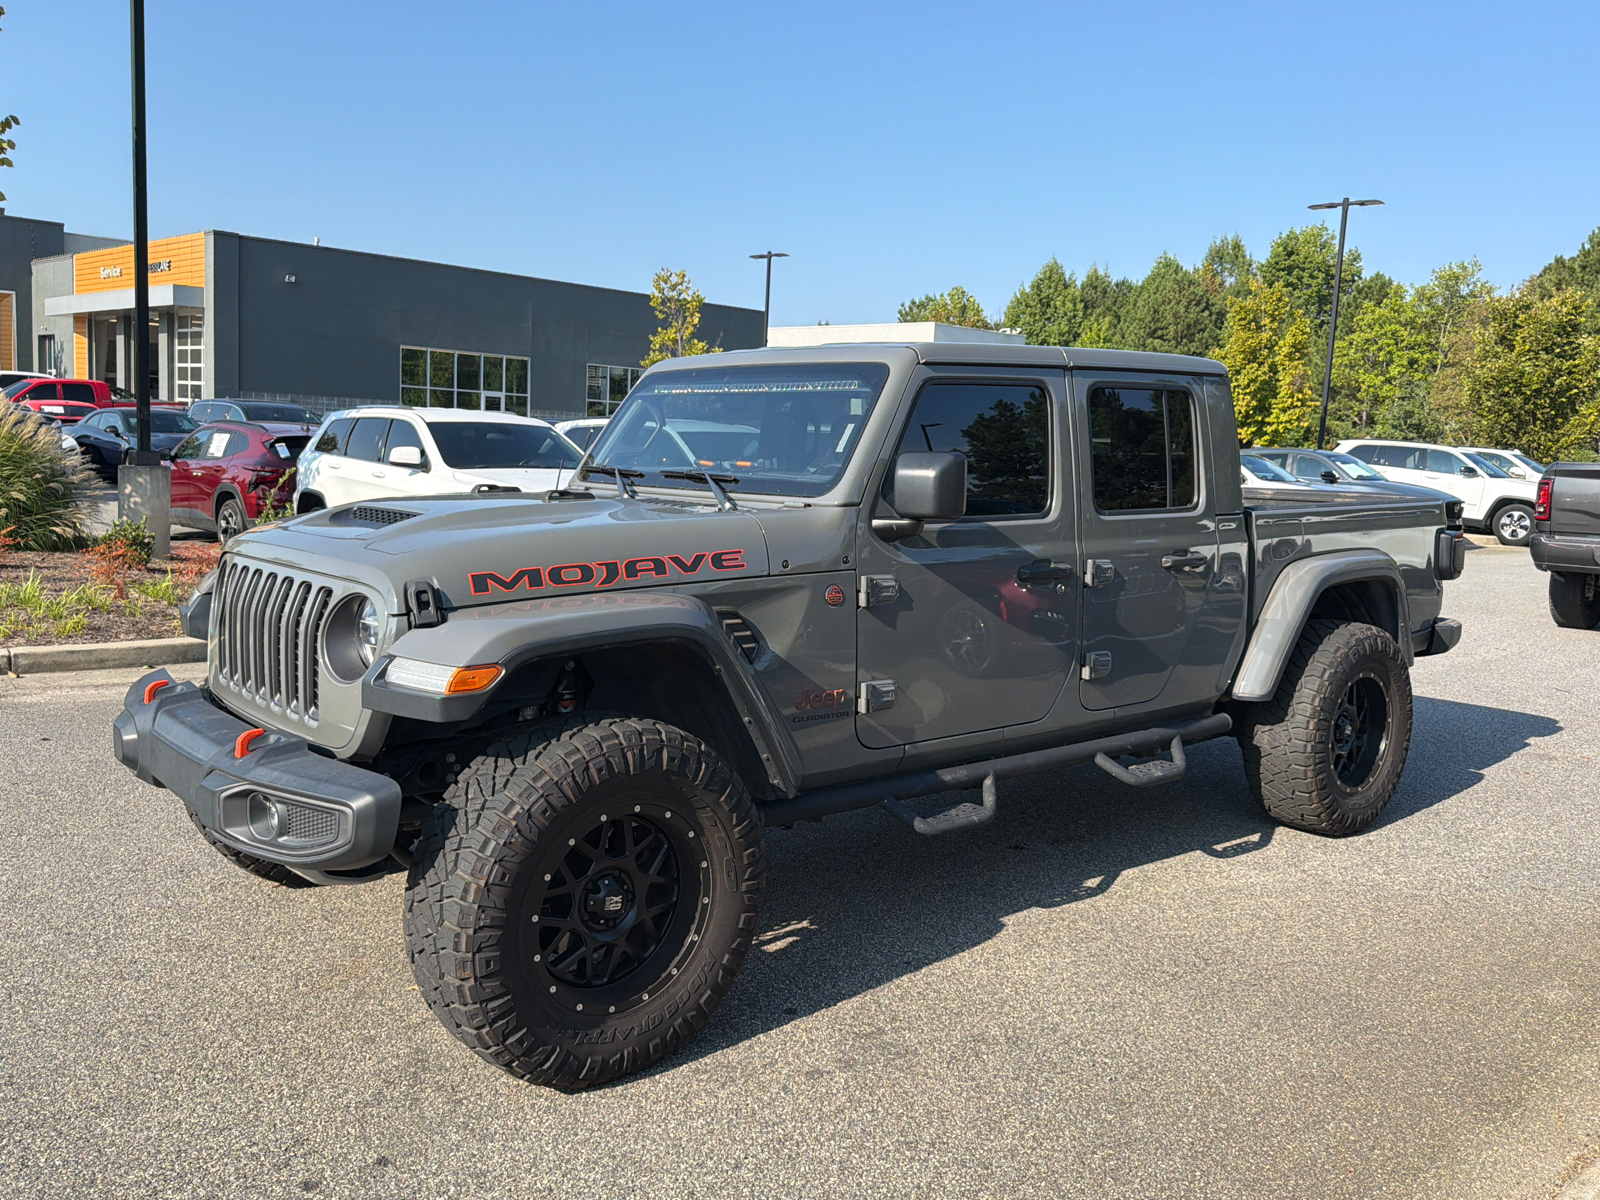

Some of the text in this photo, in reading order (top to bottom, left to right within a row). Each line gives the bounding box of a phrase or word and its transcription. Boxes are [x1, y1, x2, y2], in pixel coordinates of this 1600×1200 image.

[100, 265, 122, 279] Service
[468, 549, 747, 596] MOJAVE
[794, 687, 845, 711] Jeep
[792, 711, 850, 724] GLADIATOR
[665, 949, 718, 1020] RIDGE
